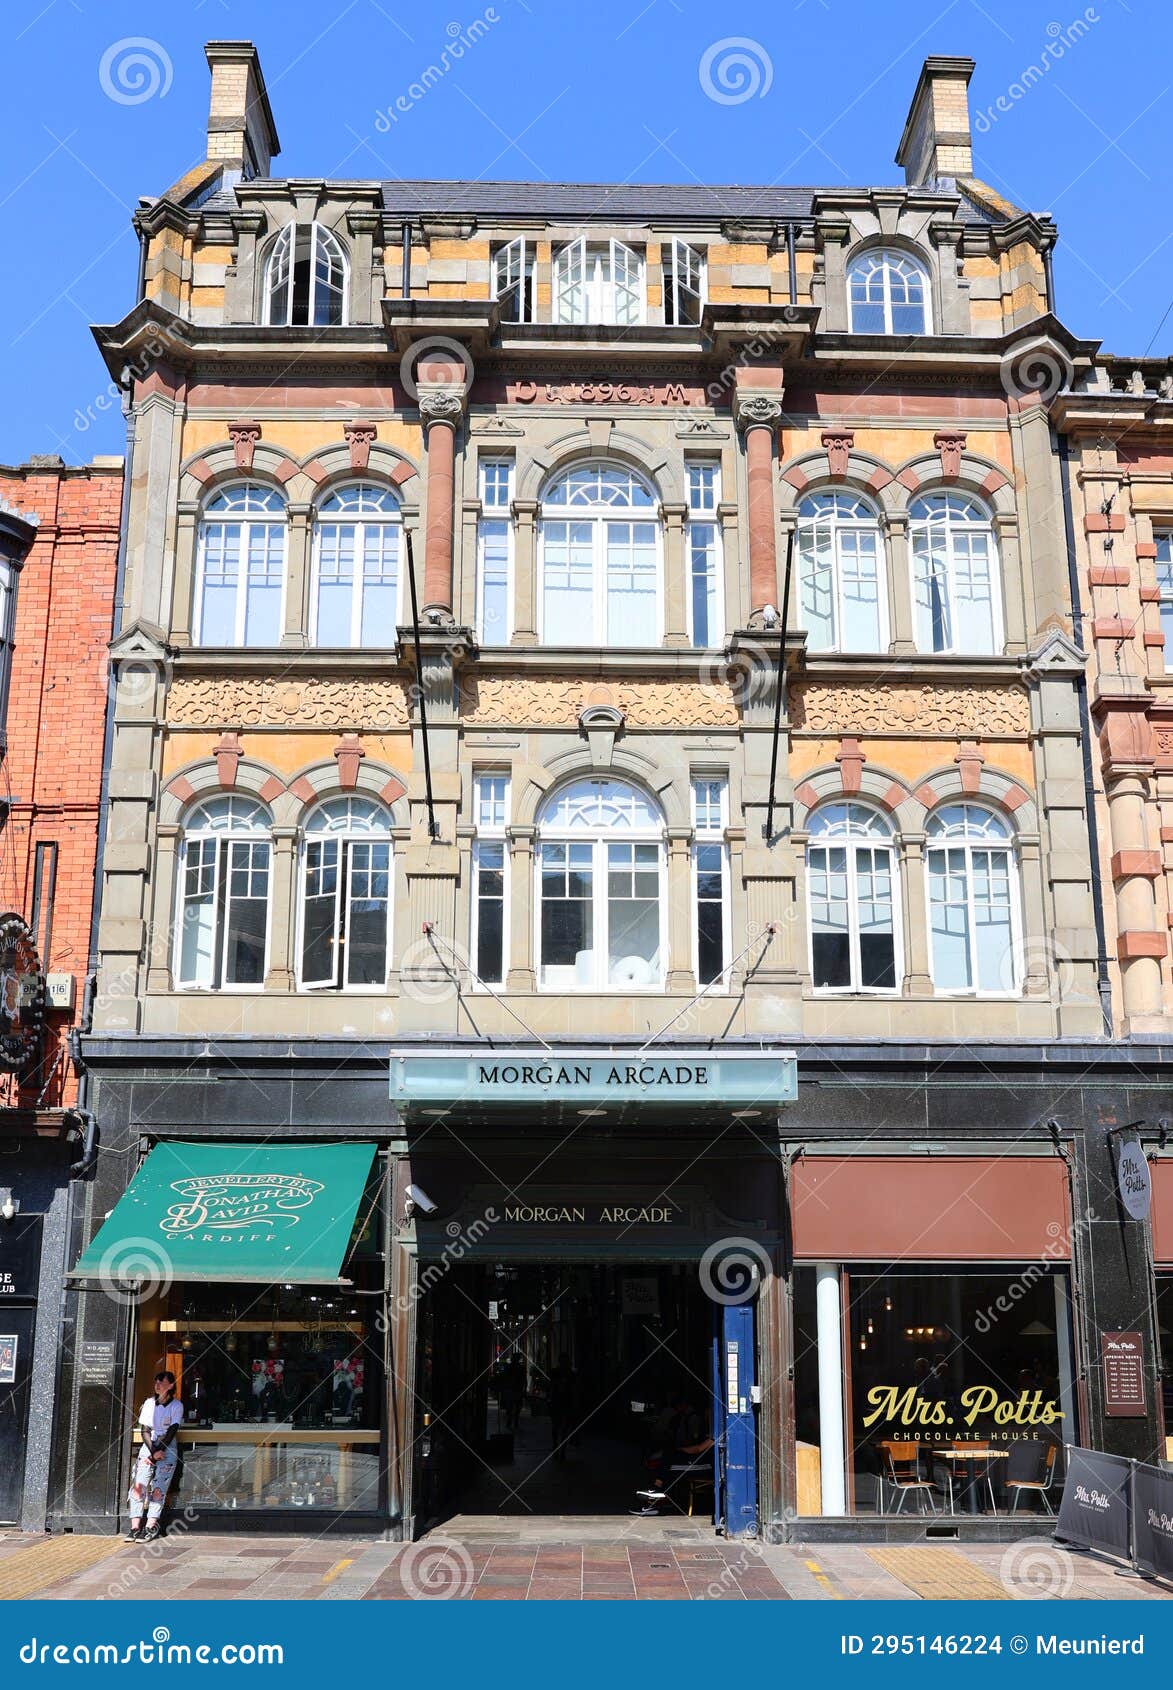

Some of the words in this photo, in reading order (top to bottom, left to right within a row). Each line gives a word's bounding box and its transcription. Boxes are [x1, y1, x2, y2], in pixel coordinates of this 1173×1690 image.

[479, 1067, 592, 1084] MORGAN
[606, 1067, 708, 1084] ARCADE
[188, 1176, 289, 1188] JEWELLERY
[288, 1178, 312, 1189] BY
[172, 1188, 313, 1216] JONATHAN
[160, 1204, 269, 1232] DAVID
[504, 1207, 585, 1223] MORGAN
[600, 1207, 673, 1223] ARCADE
[166, 1233, 277, 1243] CARDIFF
[863, 1385, 954, 1428] Mrs.
[961, 1385, 1066, 1427] Potts
[893, 1432, 981, 1441] CHOCOLATE
[991, 1432, 1039, 1441] HOUSE
